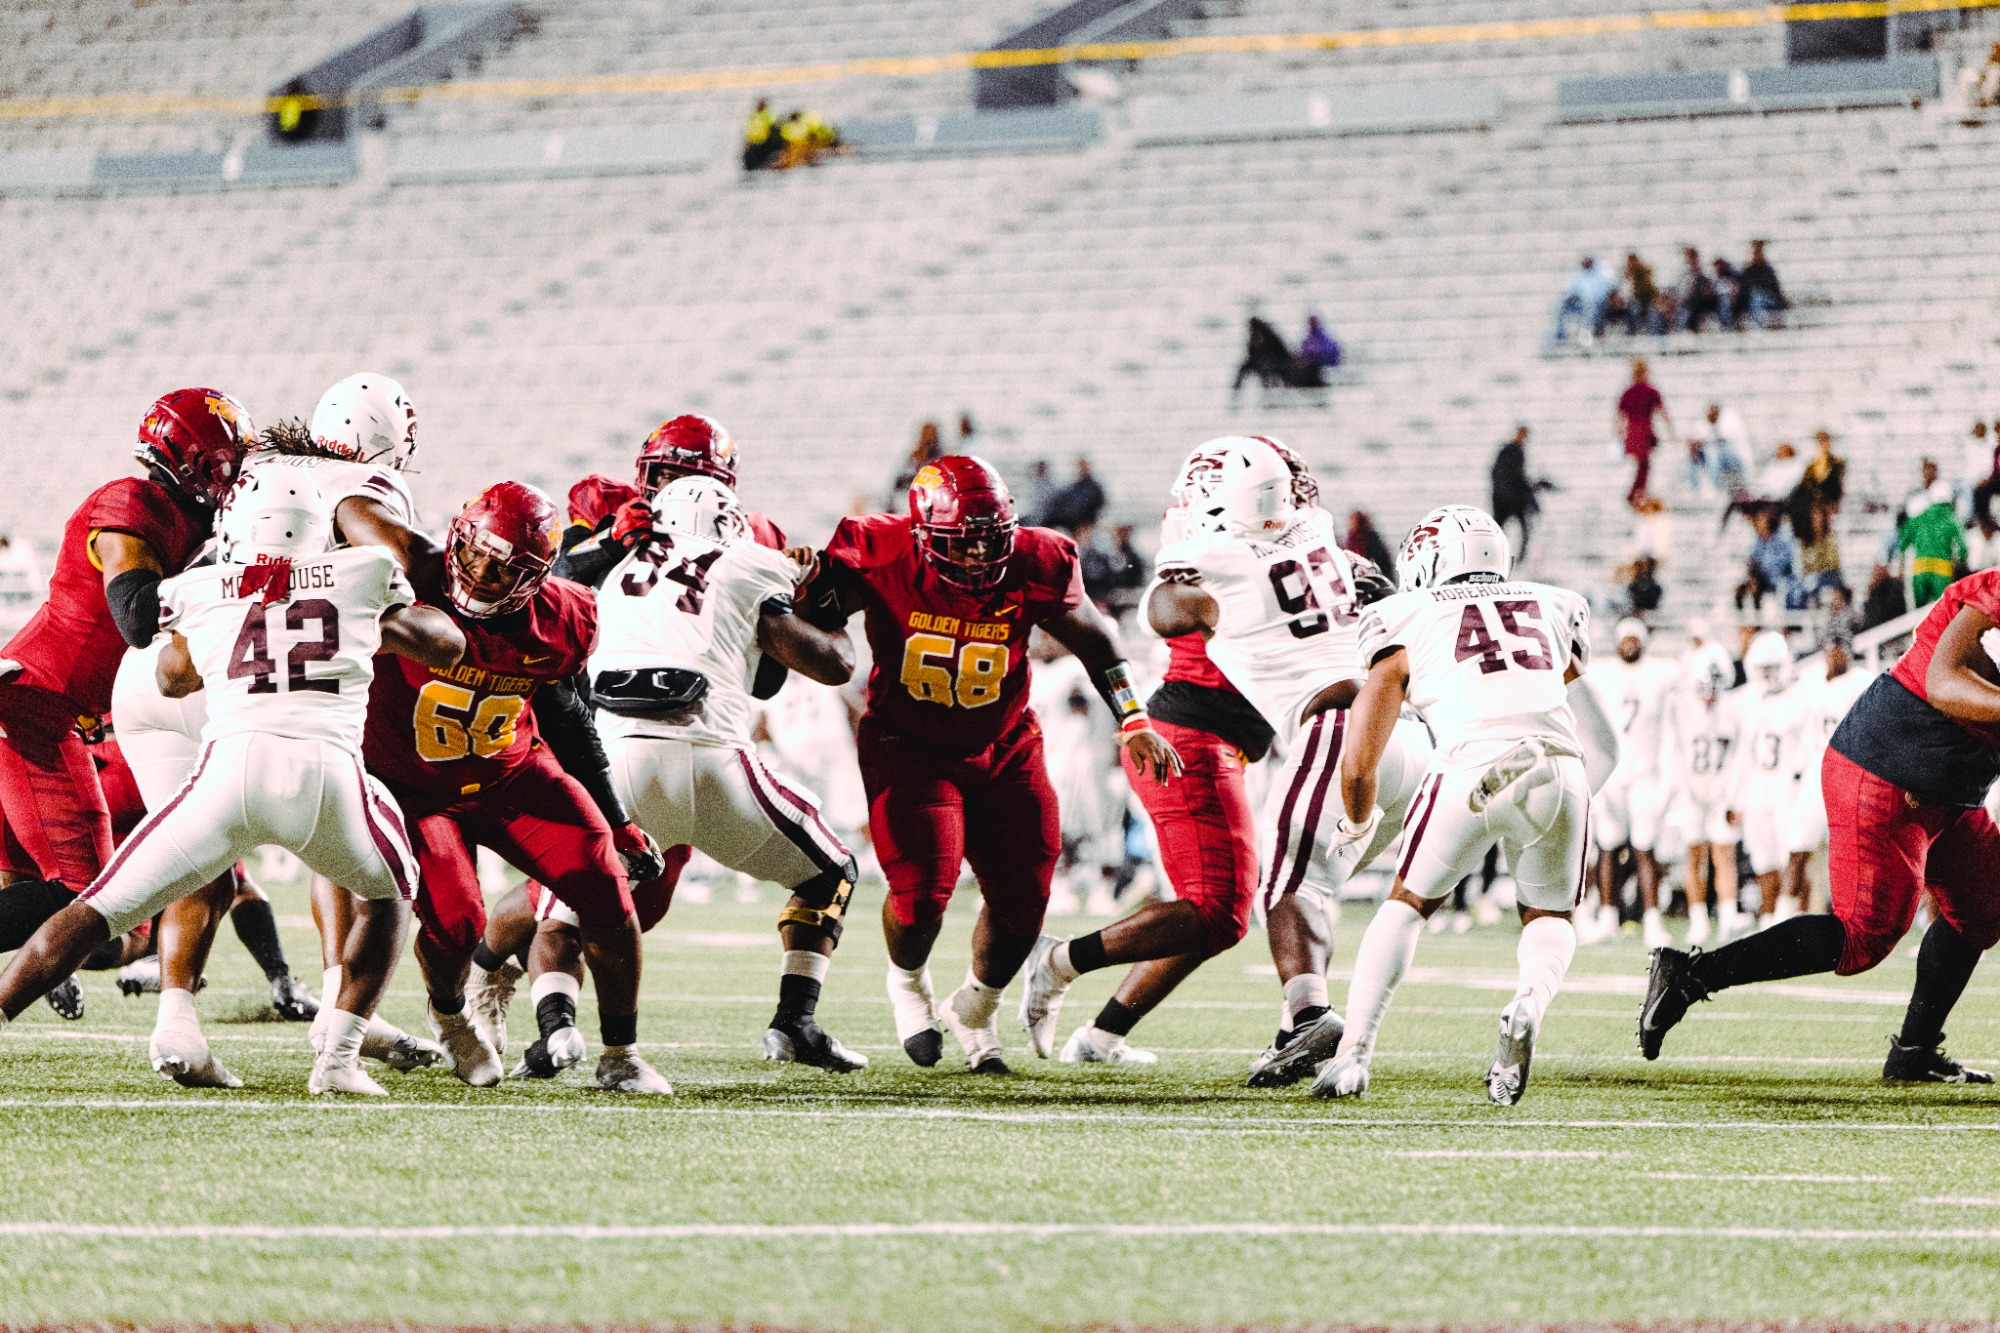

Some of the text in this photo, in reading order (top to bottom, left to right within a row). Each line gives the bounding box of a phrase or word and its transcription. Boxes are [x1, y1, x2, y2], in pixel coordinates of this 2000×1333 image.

[315, 435, 365, 463] Riddel
[221, 564, 335, 600] MOUSE
[1268, 545, 1360, 640] 93
[1468, 572, 1502, 584] schutt
[908, 611, 1010, 641] GOLDEN TIGERS
[1454, 600, 1554, 675] 45
[227, 598, 340, 695] 42
[488, 673, 535, 692] TIGERS
[900, 632, 1010, 710] 68
[412, 679, 527, 763] 60
[1692, 735, 1730, 775] 87
